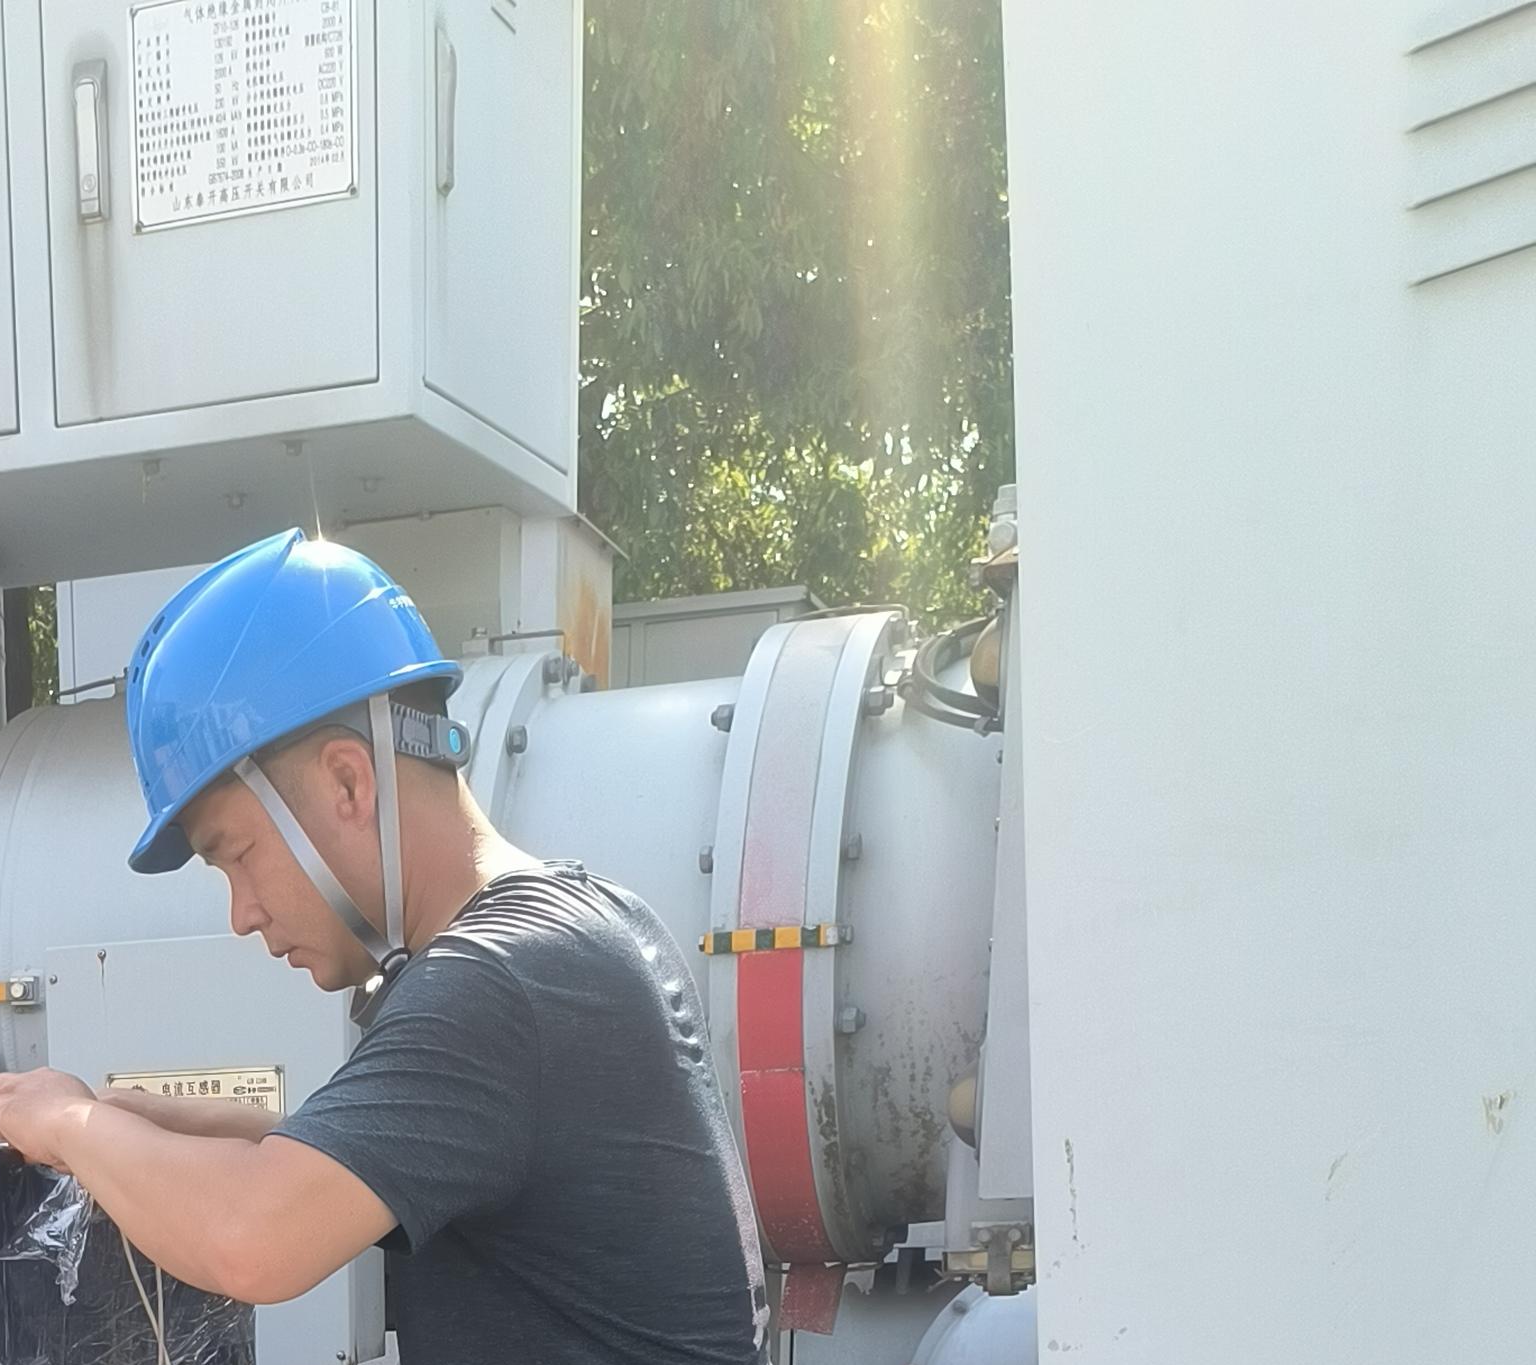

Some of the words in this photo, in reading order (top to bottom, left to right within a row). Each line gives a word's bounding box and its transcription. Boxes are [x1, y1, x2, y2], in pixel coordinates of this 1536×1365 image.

[162, 1079, 221, 1096] 电流互感器
